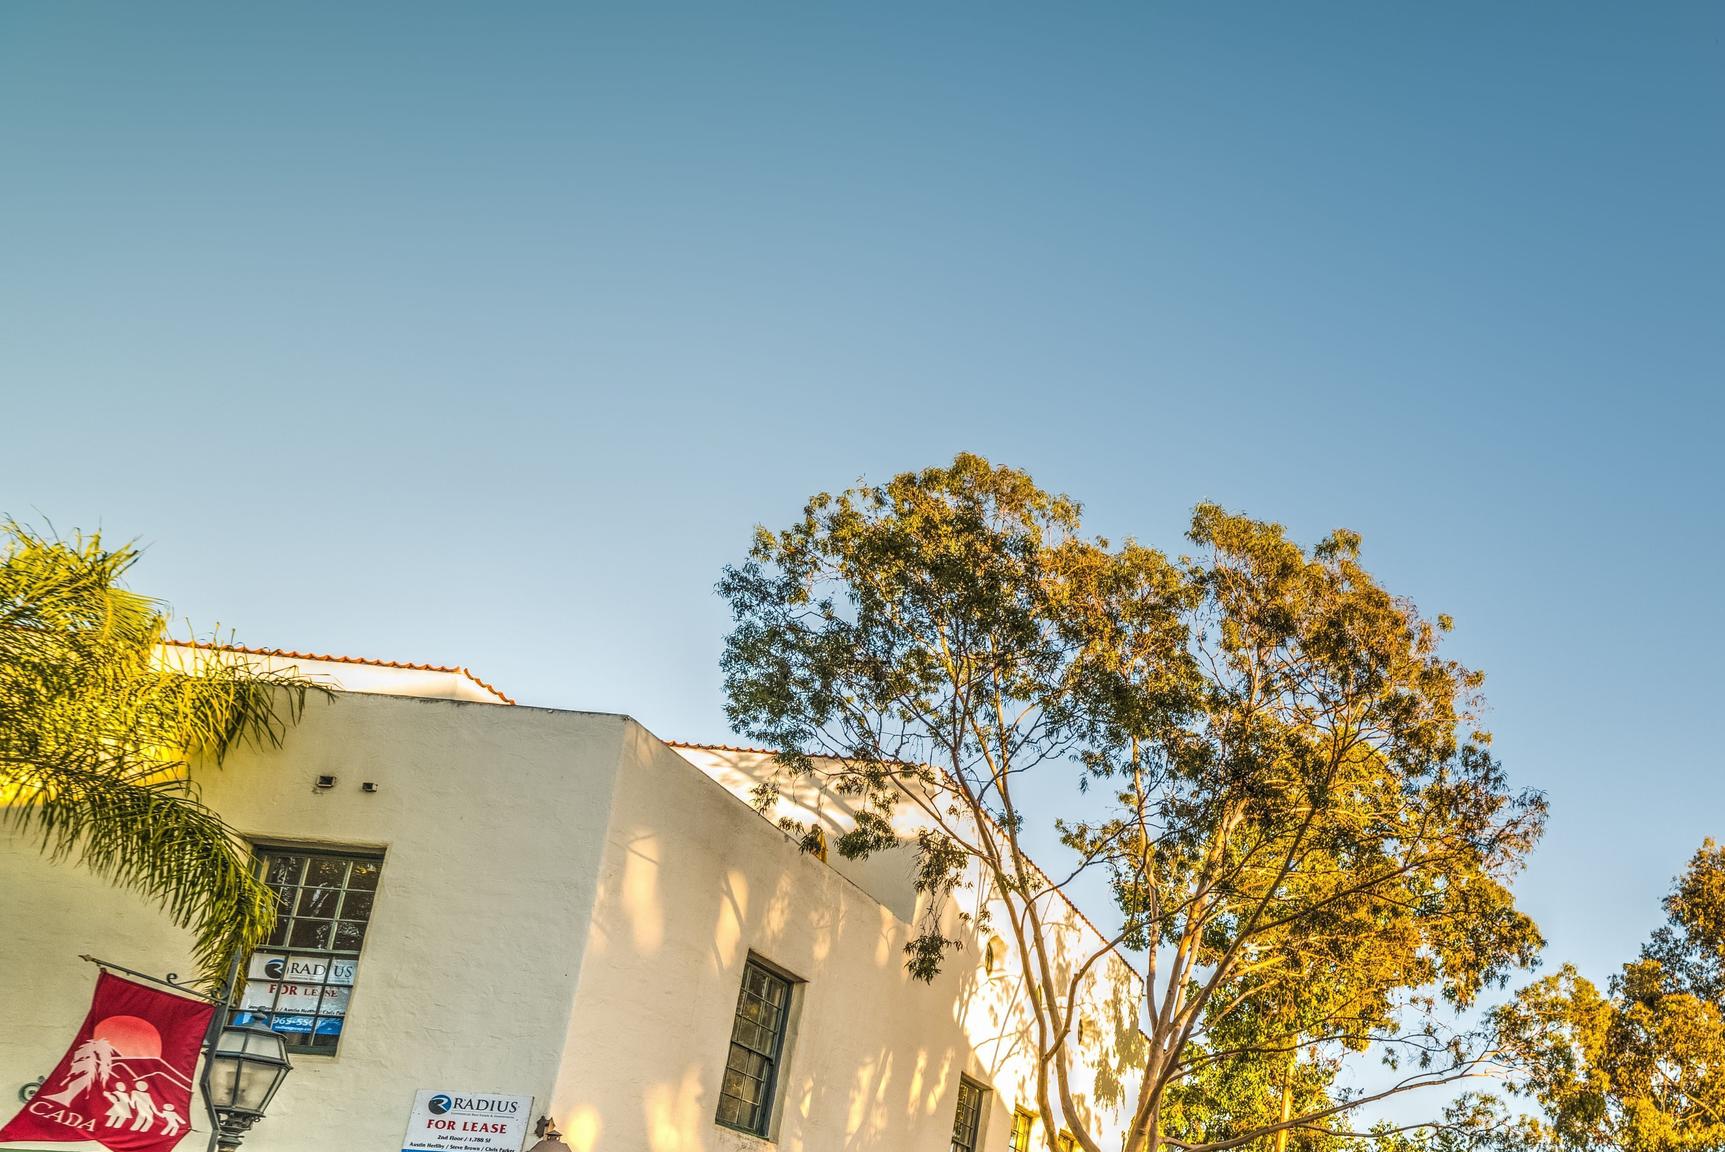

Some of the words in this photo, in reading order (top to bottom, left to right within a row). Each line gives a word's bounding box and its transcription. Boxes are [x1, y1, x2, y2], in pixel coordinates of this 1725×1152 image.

[290, 962, 353, 978] RADUS
[303, 988, 338, 998] LESE
[453, 1097, 518, 1113] RADIUS
[29, 1101, 96, 1132] CADA
[427, 1119, 456, 1130] FOR
[462, 1121, 507, 1134] LEASE
